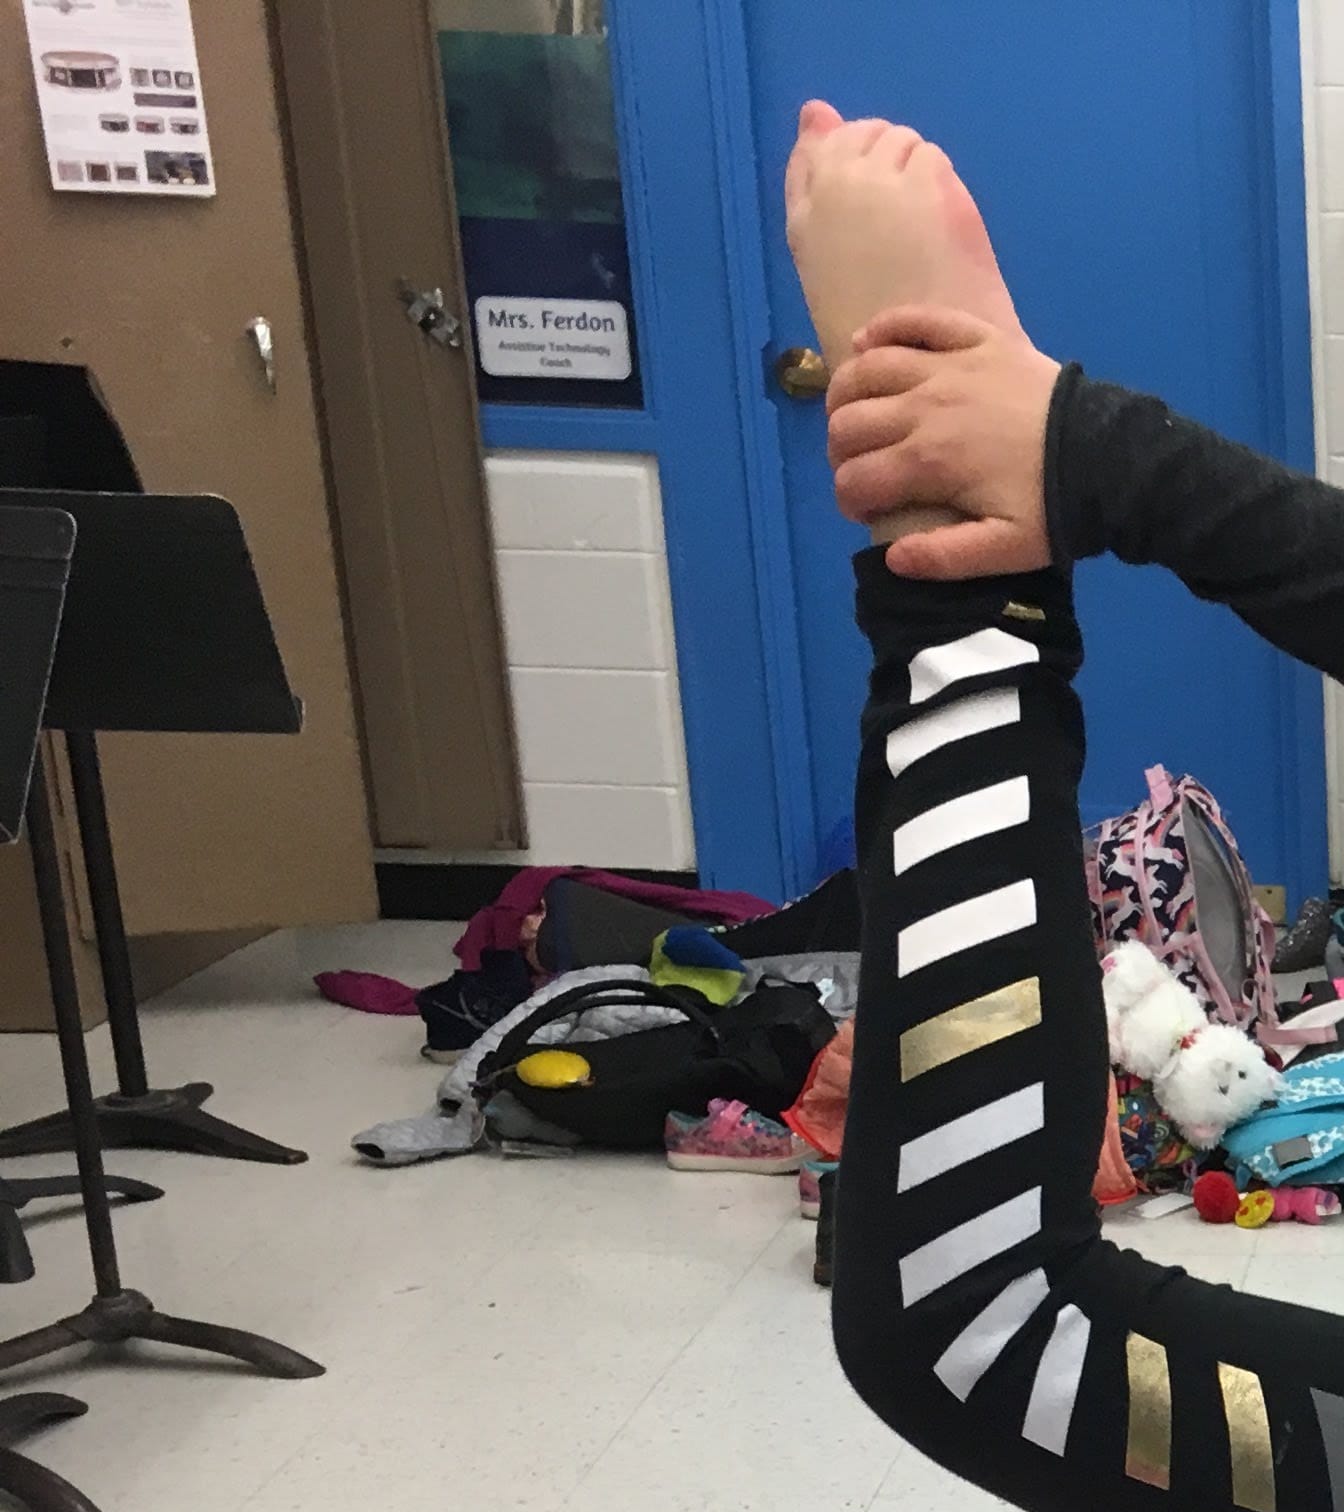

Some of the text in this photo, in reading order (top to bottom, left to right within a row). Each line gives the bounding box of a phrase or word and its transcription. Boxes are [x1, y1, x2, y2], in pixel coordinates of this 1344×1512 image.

[488, 309, 616, 332] Mrs. Ferdon
[549, 341, 611, 356] Technology
[539, 356, 572, 367] Coach
